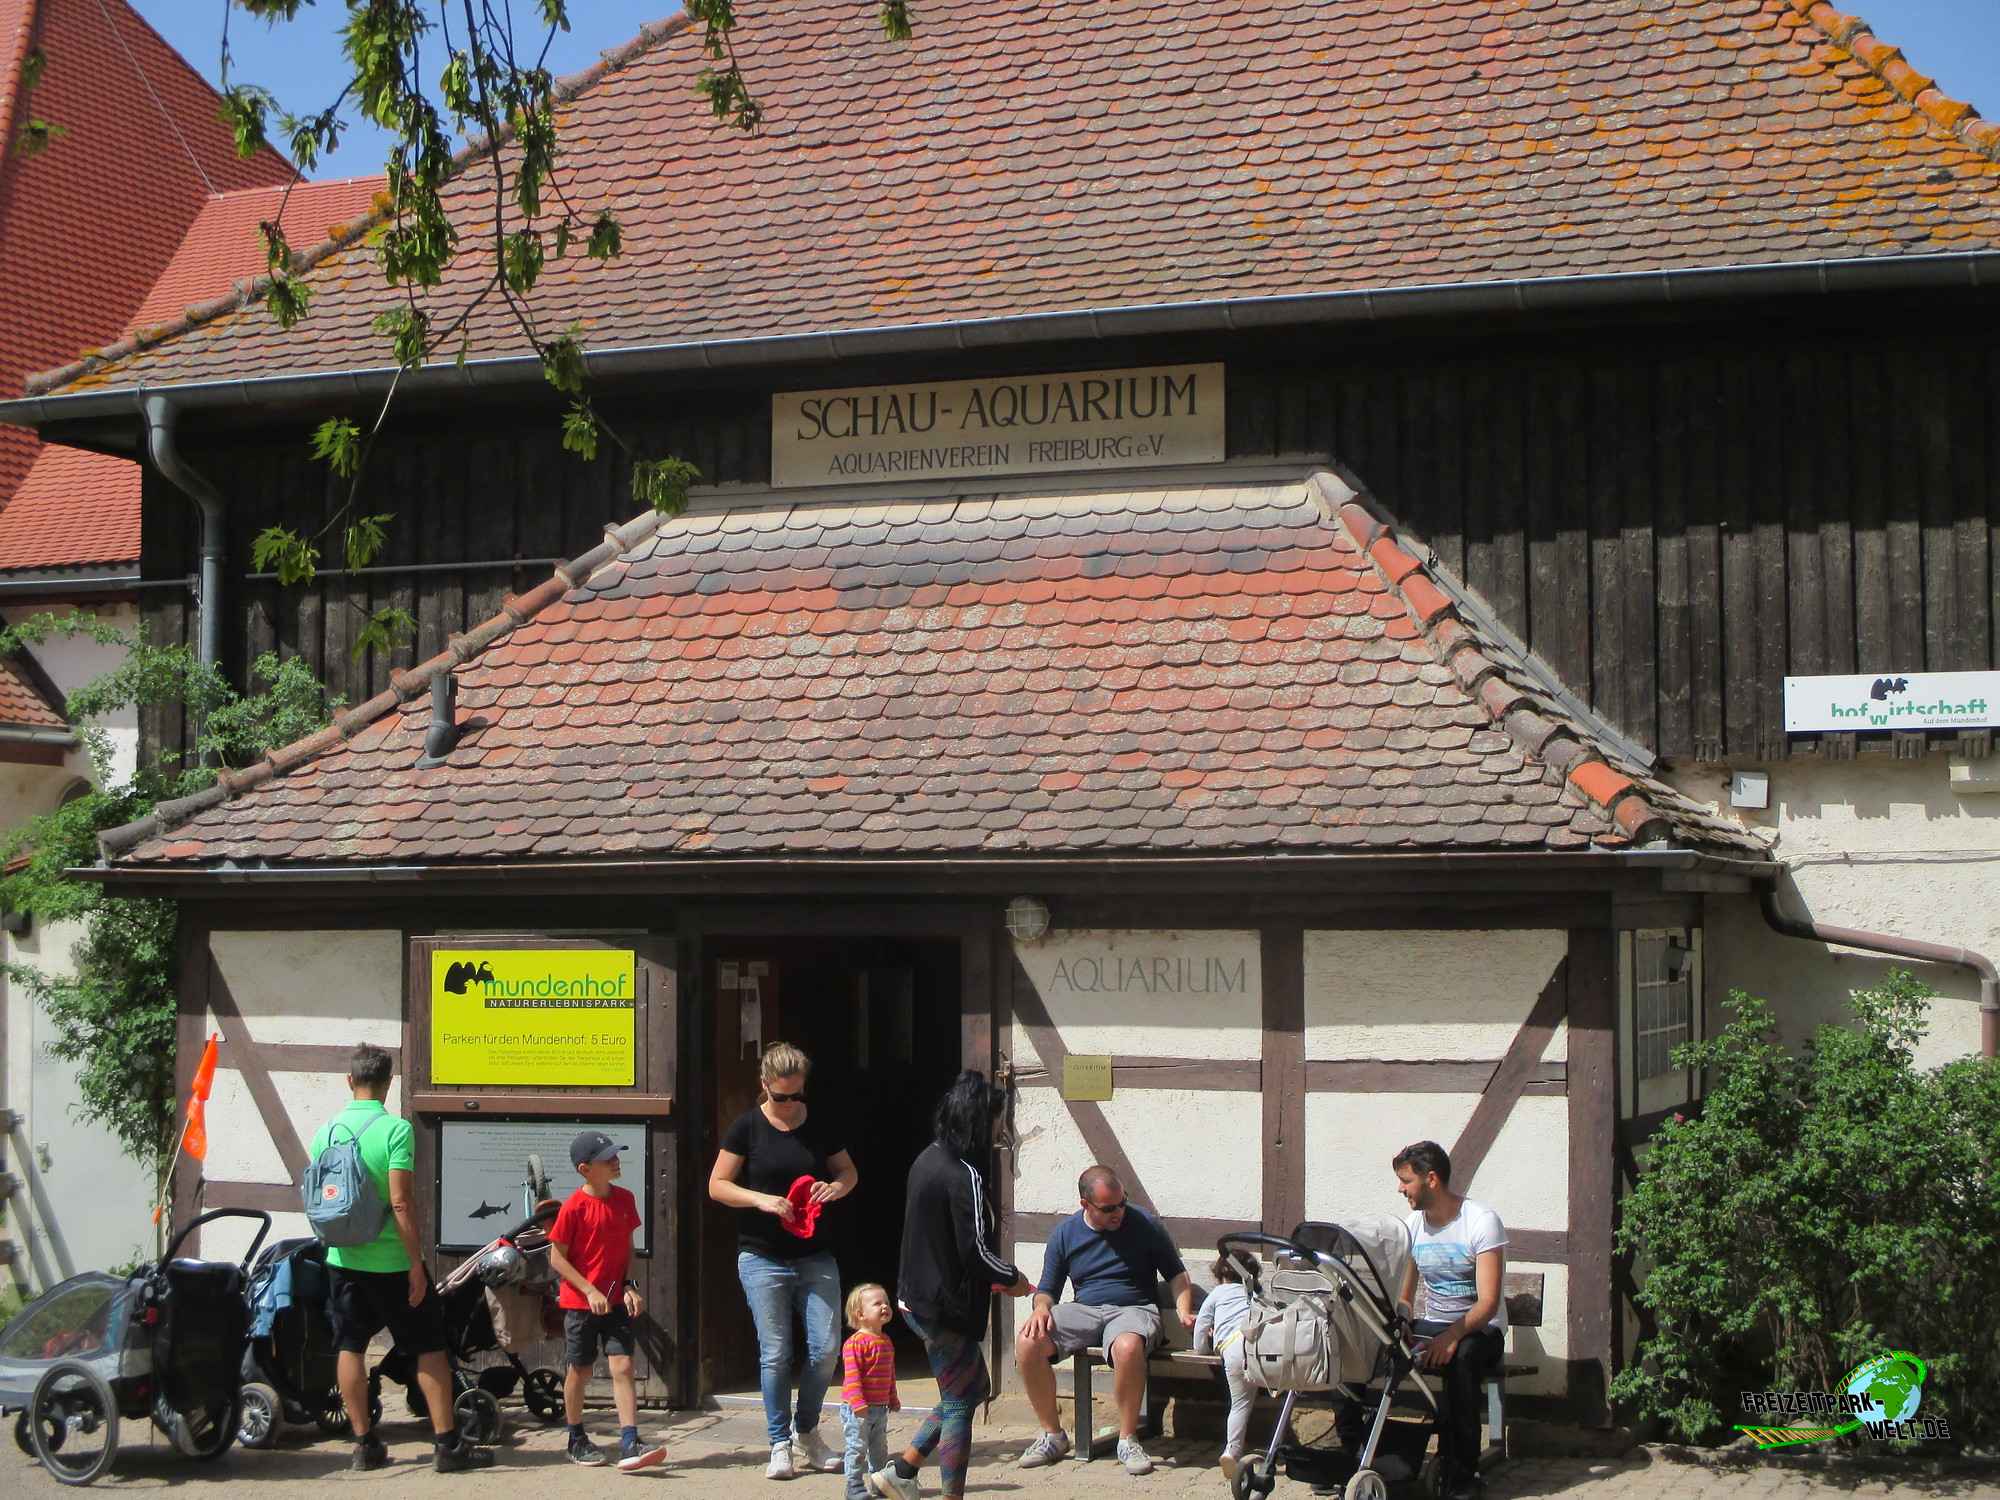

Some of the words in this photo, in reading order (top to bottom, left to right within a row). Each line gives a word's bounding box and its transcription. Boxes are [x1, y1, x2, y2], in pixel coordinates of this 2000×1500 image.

[827, 443, 1010, 476] AQUARIENVEREIN
[1028, 435, 1132, 463] FREIBURG
[484, 973, 626, 997] mundenhof
[1048, 956, 1247, 993] AQUARIUM
[490, 999, 626, 1008] NATURERLEBNISPARK
[443, 1033, 481, 1046] Parken
[484, 1033, 497, 1046] für
[499, 1033, 519, 1046] den
[591, 1033, 599, 1046] 5
[601, 1033, 627, 1046] Euro
